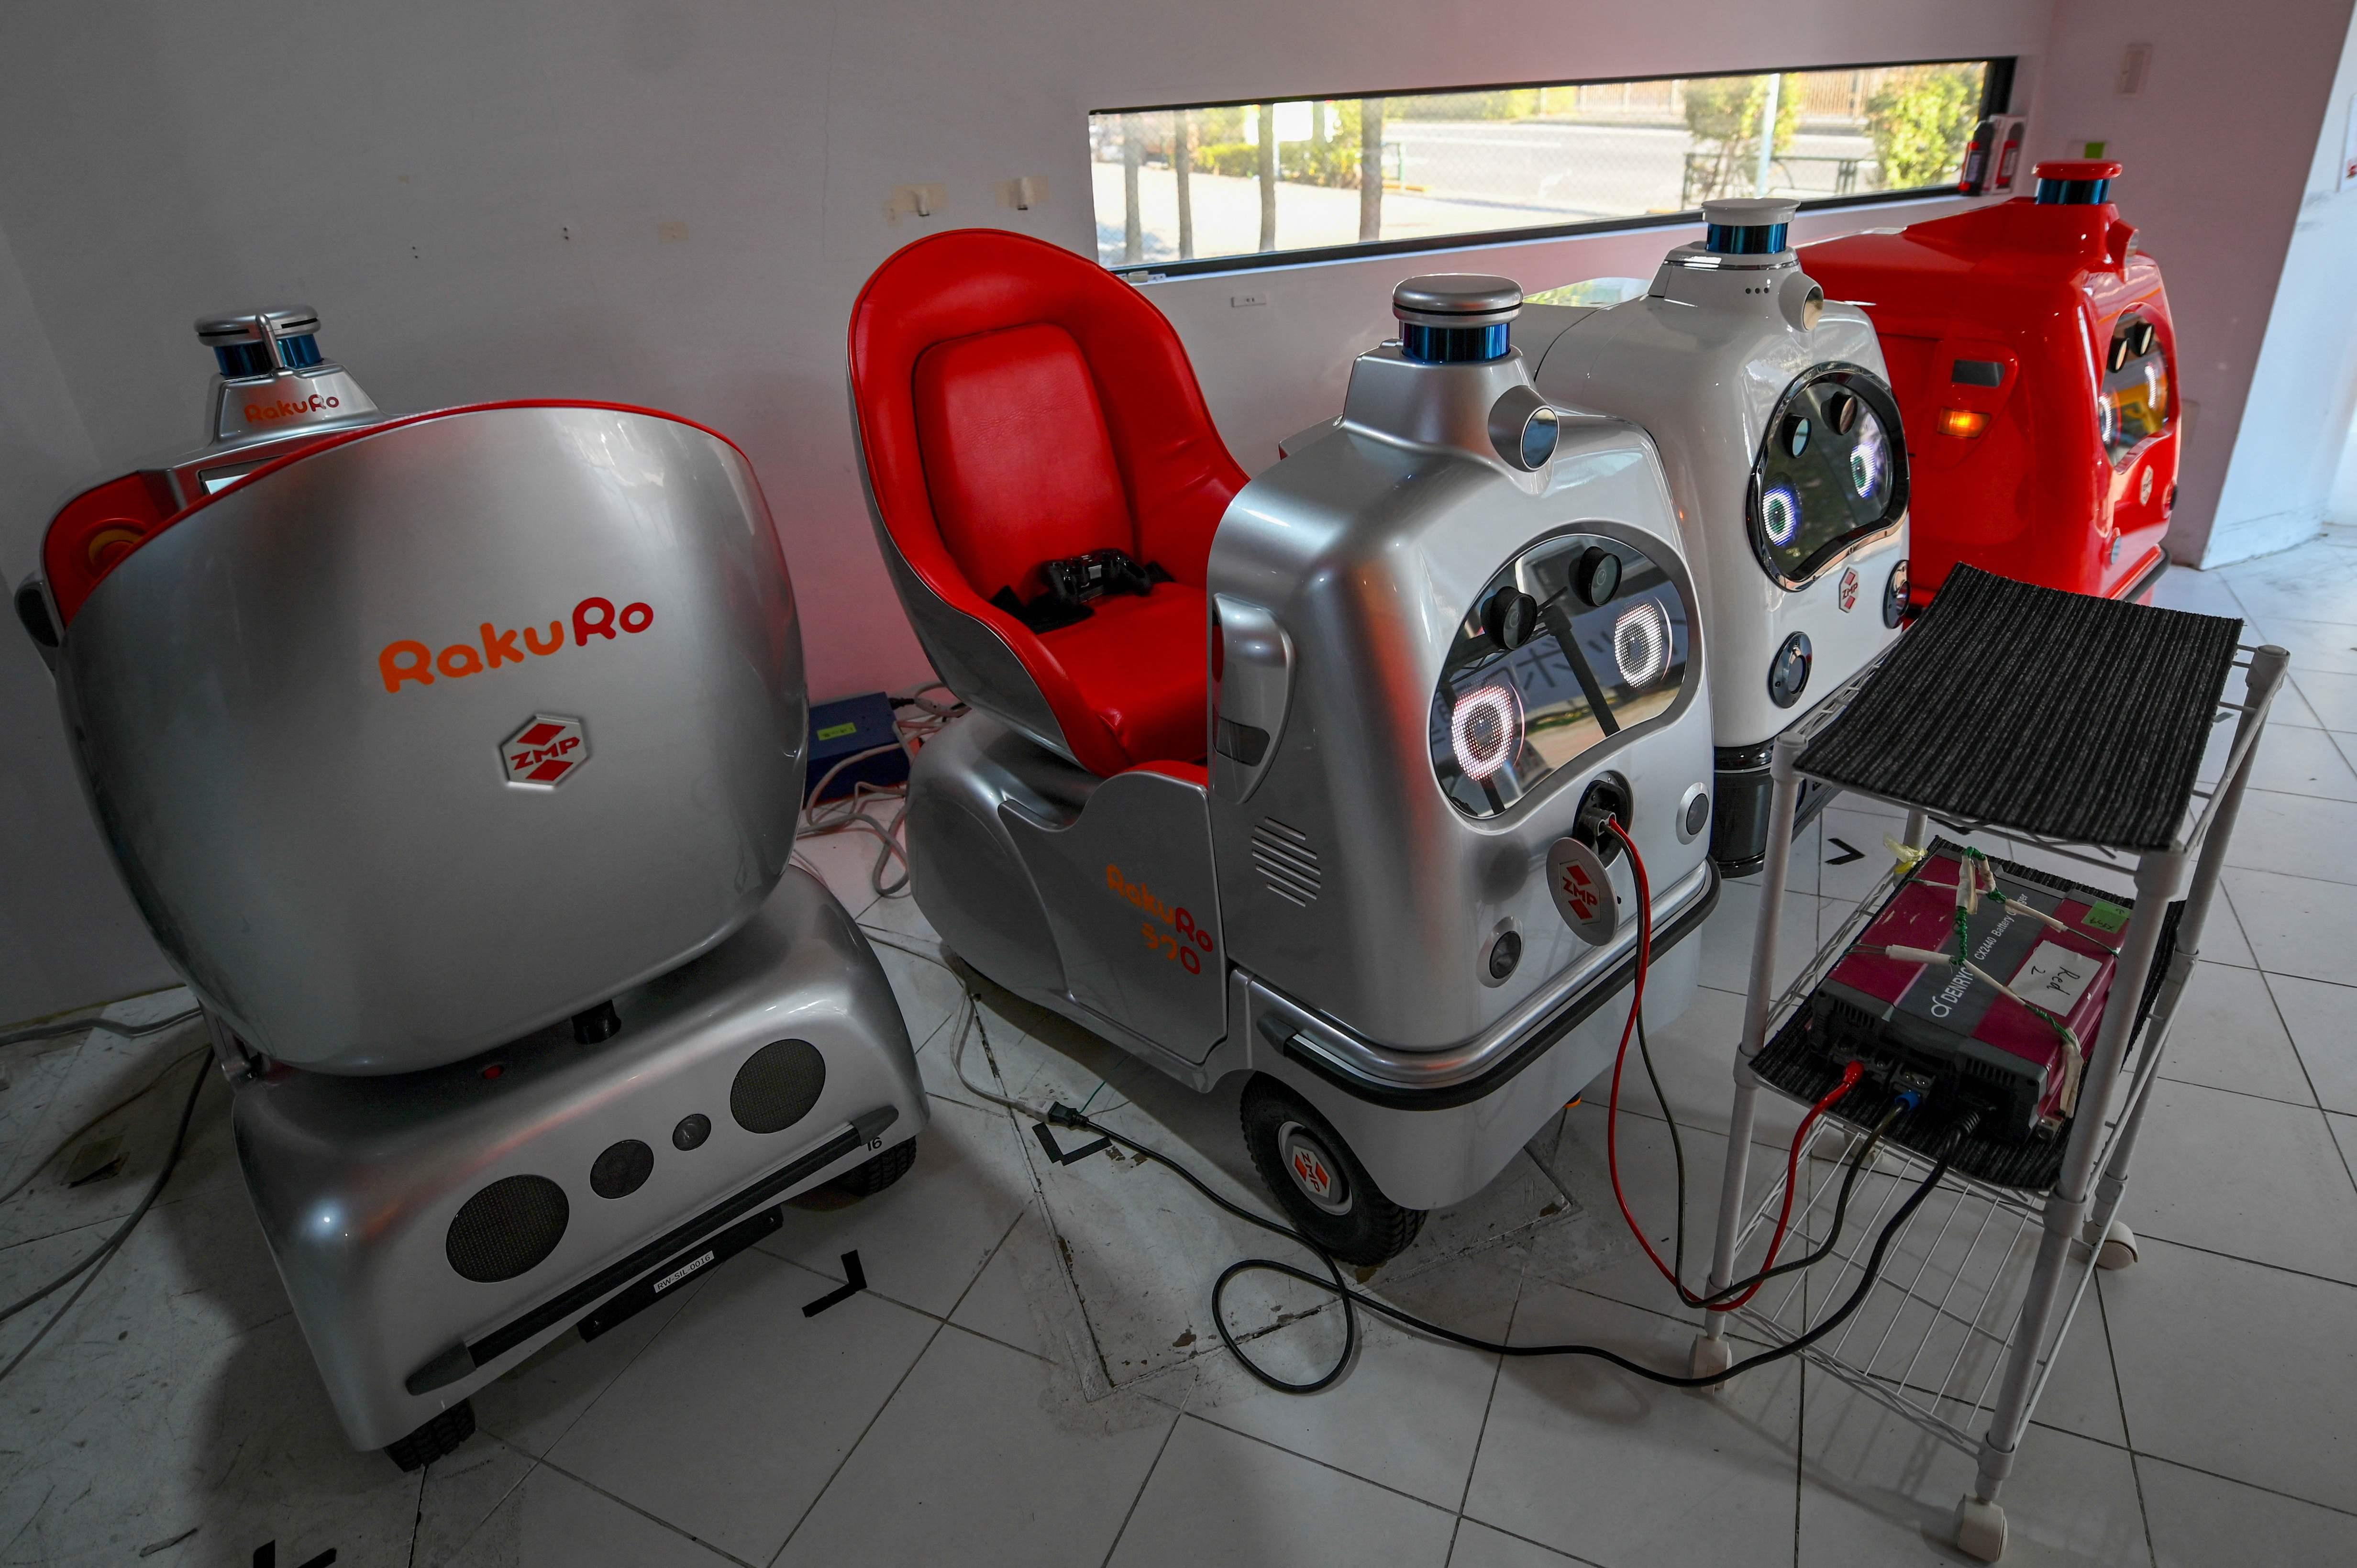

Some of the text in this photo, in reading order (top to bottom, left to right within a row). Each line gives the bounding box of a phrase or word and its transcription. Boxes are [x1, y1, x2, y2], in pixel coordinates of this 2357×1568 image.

[244, 394, 339, 423] RakuRo
[1842, 582, 1859, 600] ZMP
[379, 596, 654, 694] RakuRo
[510, 736, 580, 771] ZMP
[1562, 876, 1598, 906] ZMP
[1106, 863, 1214, 952] RakuRo
[1974, 894, 2028, 961] CX2440 Battery Cger
[2031, 966, 2046, 975] 2
[2046, 966, 2080, 996] Red
[867, 1137, 883, 1151] 16
[1301, 1151, 1321, 1193] ZMP
[657, 1254, 711, 1290] RW-SIL-0016
